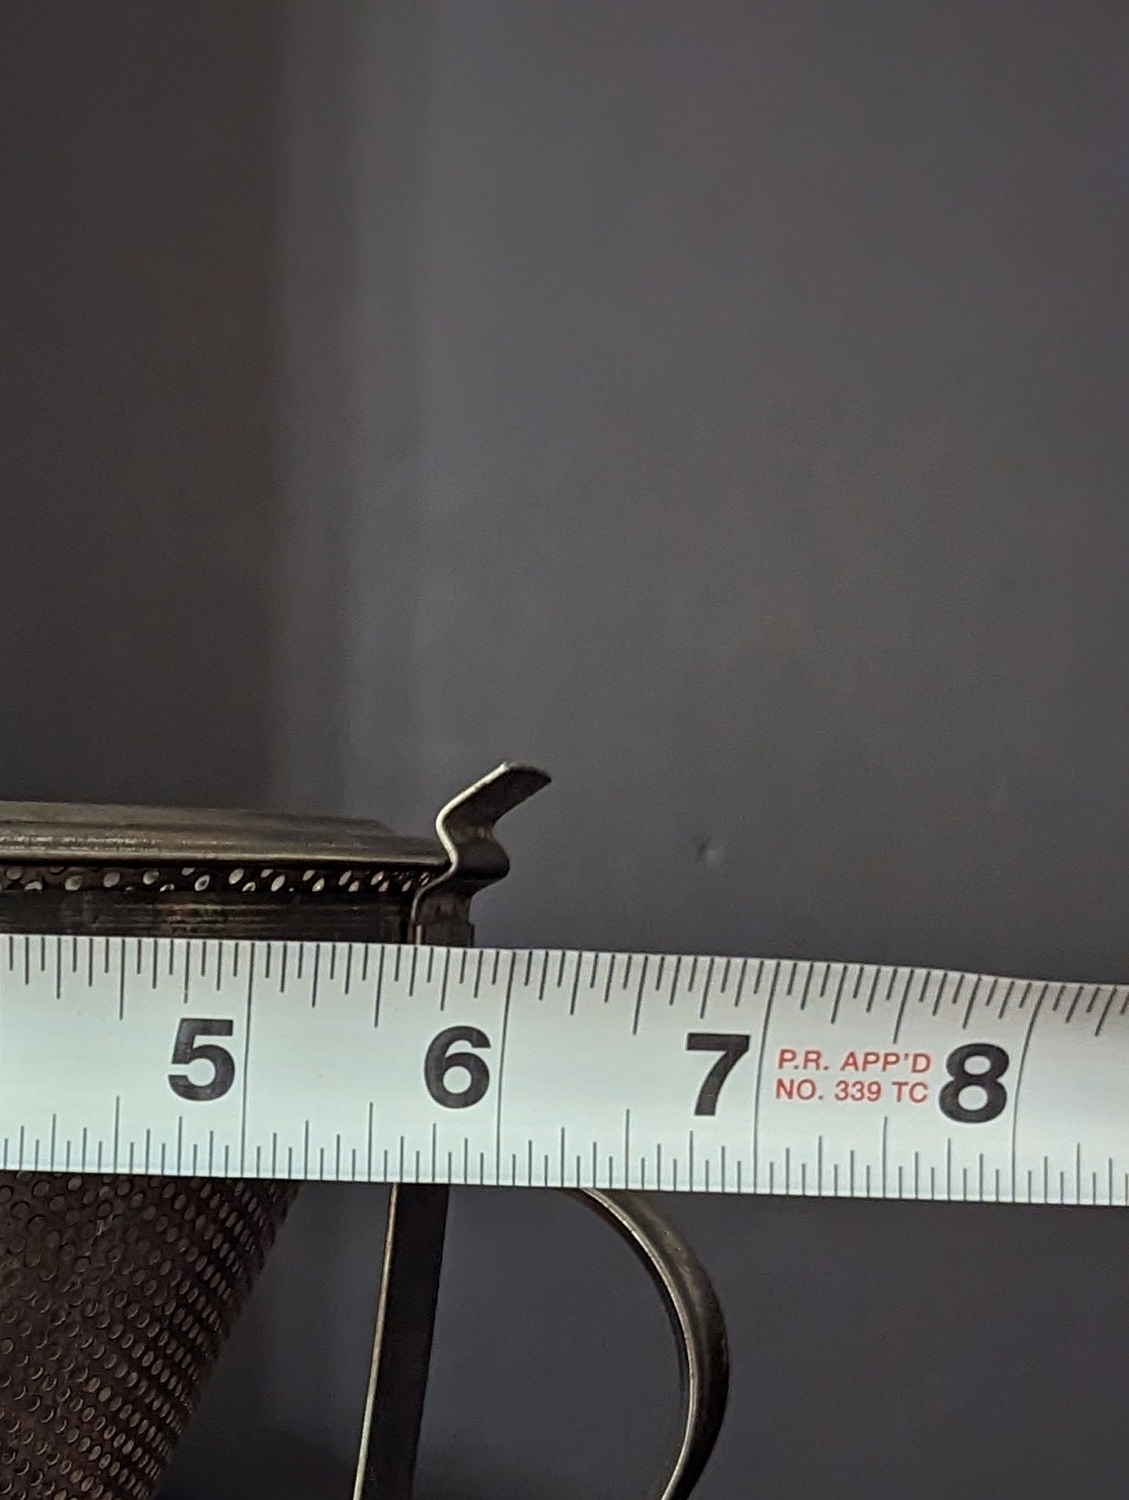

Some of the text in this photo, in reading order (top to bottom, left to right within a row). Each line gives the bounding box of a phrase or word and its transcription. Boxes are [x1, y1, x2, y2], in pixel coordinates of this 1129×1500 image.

[168, 1018, 236, 1102] 5
[423, 1026, 492, 1110] 6
[685, 1033, 751, 1117] 7
[775, 1078, 929, 1104] NO. 339 TC
[777, 1048, 932, 1074] P.R. APP'D
[938, 1042, 1010, 1124] 8
